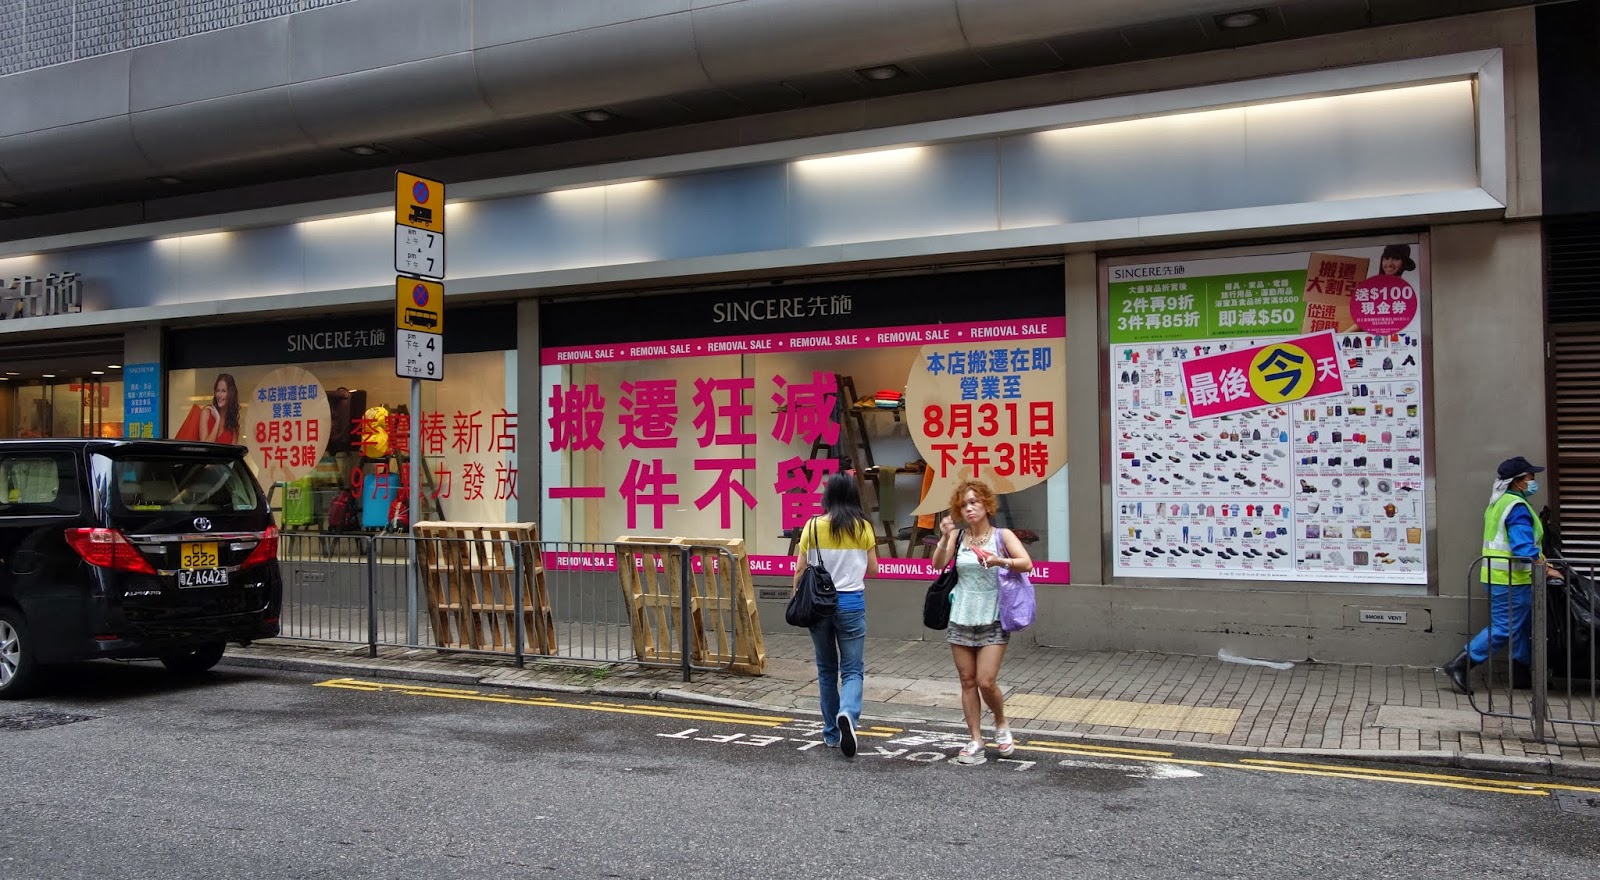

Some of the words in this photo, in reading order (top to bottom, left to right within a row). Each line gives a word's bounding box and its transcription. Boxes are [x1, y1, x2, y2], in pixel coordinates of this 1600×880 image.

[427, 234, 434, 248] 7
[405, 260, 418, 269] 下午
[427, 257, 434, 272] 7
[1319, 260, 1357, 279] 搬遷
[1355, 285, 1413, 301] 送$100
[1122, 294, 1194, 313] 2件再9折
[1361, 301, 1406, 315] 現金券
[1117, 311, 1200, 331] 3件再85折
[1219, 308, 1295, 327] 即減$50
[405, 340, 419, 350] 下午
[426, 337, 435, 351] 4
[557, 350, 593, 361] REMOVAL
[595, 349, 614, 359] SALE
[630, 345, 668, 357] REMOVAL
[670, 344, 690, 354] SALE
[707, 341, 748, 352] REMOVAL
[750, 339, 771, 350] SALE
[790, 336, 832, 348] REMOVAL
[835, 335, 858, 345] SALE
[877, 331, 922, 343] REMOVAL
[925, 329, 949, 341] SALE
[970, 326, 1019, 338] REMOVAL
[1022, 324, 1047, 335] SALE
[427, 361, 435, 376] 9
[927, 346, 1052, 376] 本店搬遷在即
[258, 384, 318, 403] 本店搬遷在即
[960, 375, 1022, 400] 營業至
[272, 402, 302, 419] 營業至
[547, 371, 841, 452] 搬遷狂減
[923, 401, 1054, 438] 8月31日
[255, 419, 319, 444] 8月31日
[259, 444, 317, 469] 下午3時
[931, 441, 1049, 478] 下午3時
[548, 456, 840, 530] 一件不留
[192, 544, 208, 555] CL
[184, 554, 216, 567] 3222
[750, 560, 771, 571] SALE
[878, 563, 922, 574] REMOVAL
[656, 728, 826, 751] LEFT
